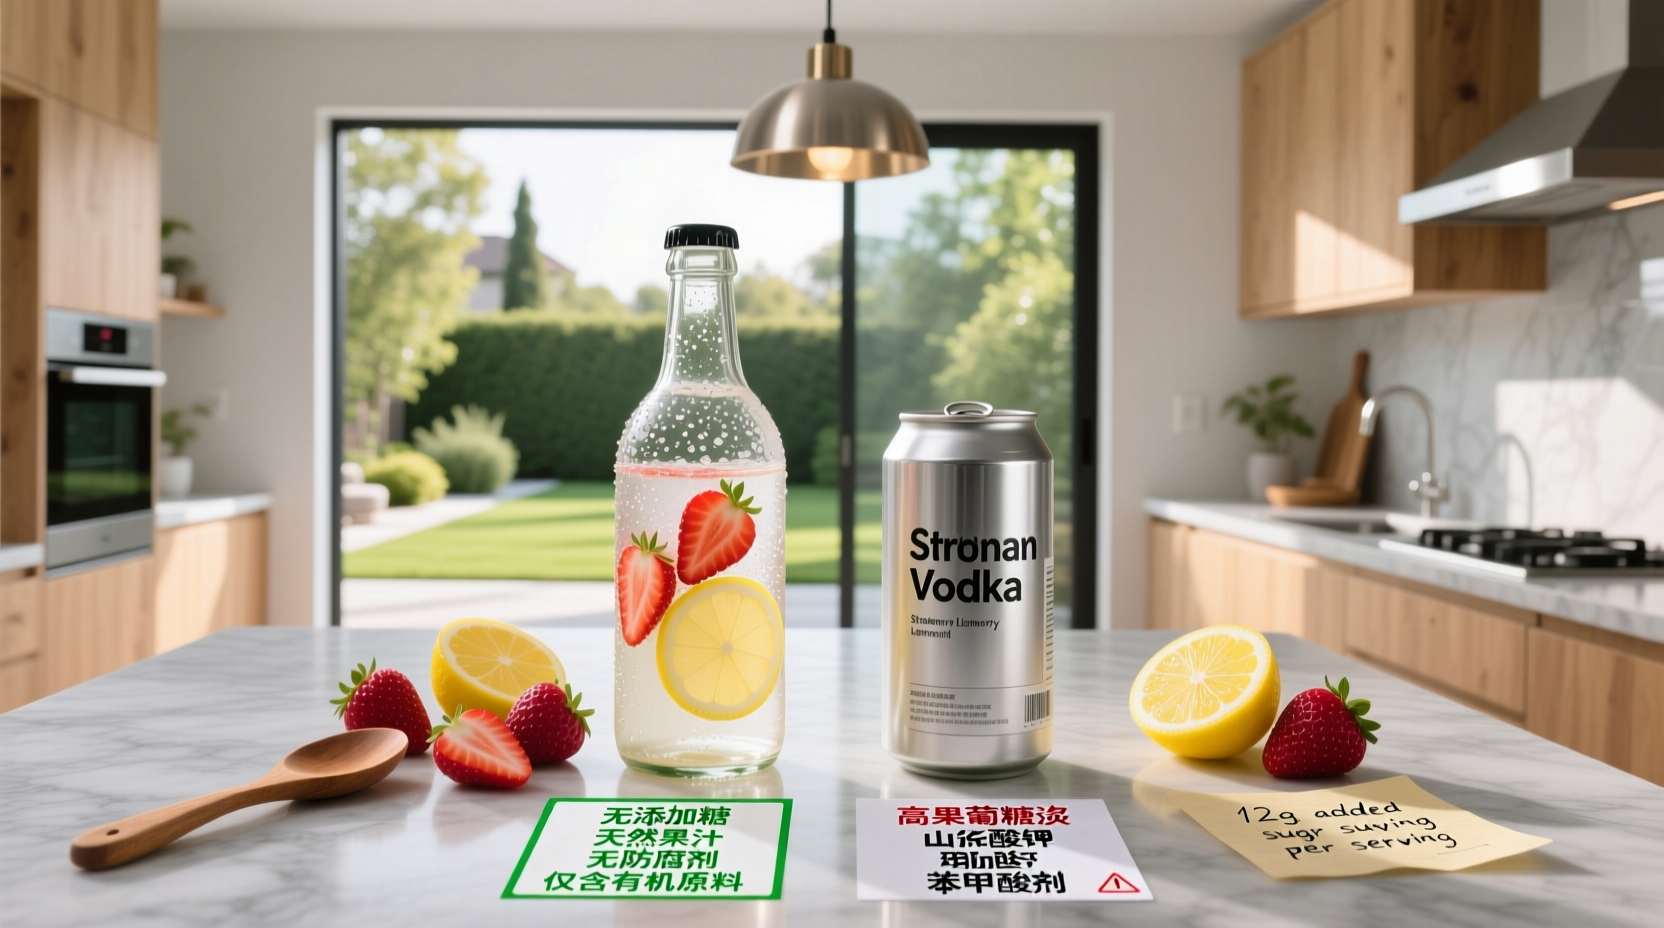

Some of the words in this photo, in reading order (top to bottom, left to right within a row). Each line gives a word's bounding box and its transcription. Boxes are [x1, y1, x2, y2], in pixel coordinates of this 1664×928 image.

[910, 568, 1022, 603] Vodka
[600, 805, 732, 826] 无添加糖
[1314, 801, 1402, 818] added
[593, 828, 724, 848] 天然果汁
[1262, 828, 1323, 842] sugr
[1285, 844, 1334, 860] per
[1351, 833, 1457, 851] serving
[586, 849, 719, 869] 无防腐剂
[544, 871, 744, 892] 仅含有机原料
